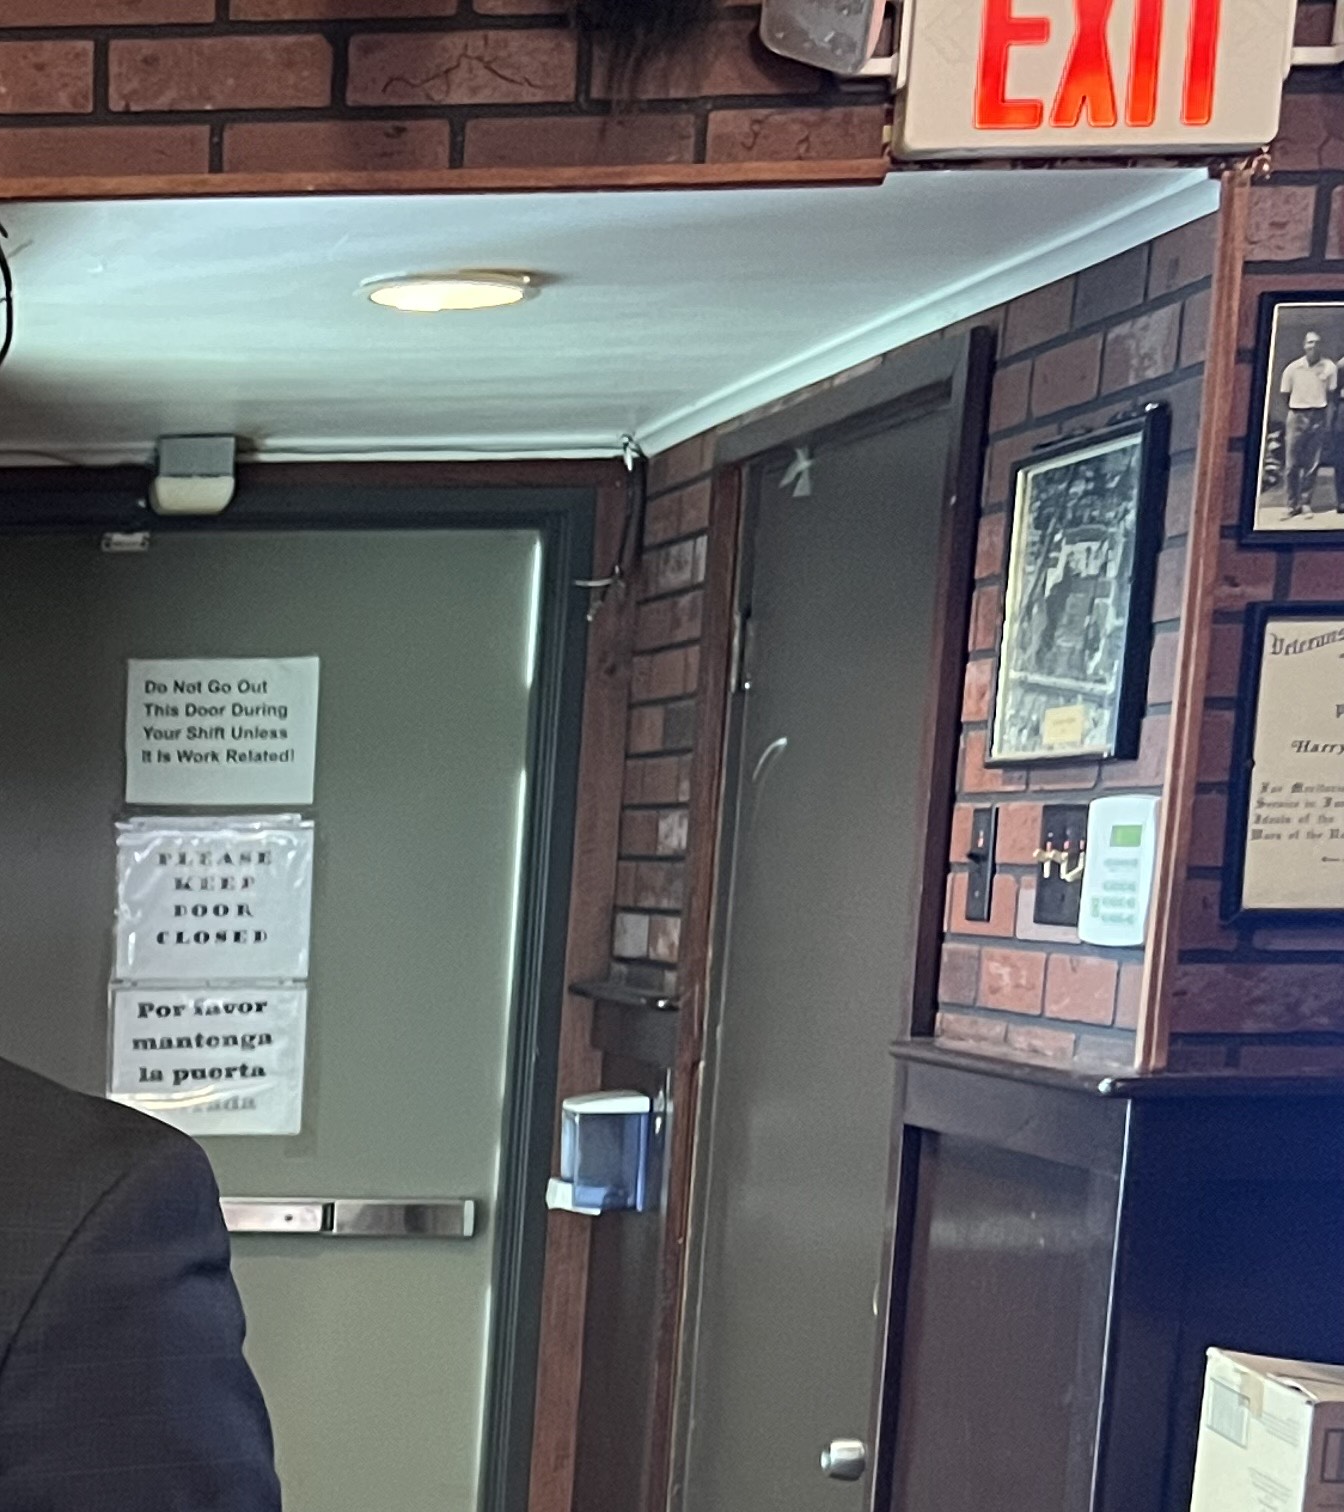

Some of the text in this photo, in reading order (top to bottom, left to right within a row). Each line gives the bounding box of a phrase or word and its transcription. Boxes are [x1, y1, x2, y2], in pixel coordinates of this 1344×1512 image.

[144, 679, 268, 694] Do Not Go Out
[143, 702, 288, 720] This Door During
[143, 725, 288, 741] Your Shift Unless
[141, 748, 295, 763] It Is Work Related!
[159, 851, 272, 866] PLEASE
[174, 876, 255, 890] KEEP
[174, 904, 254, 917] DOOR
[156, 930, 268, 944] CLOSED
[137, 1001, 186, 1018] Por
[132, 1032, 273, 1050] mantenga
[139, 1063, 267, 1086] la puerta
